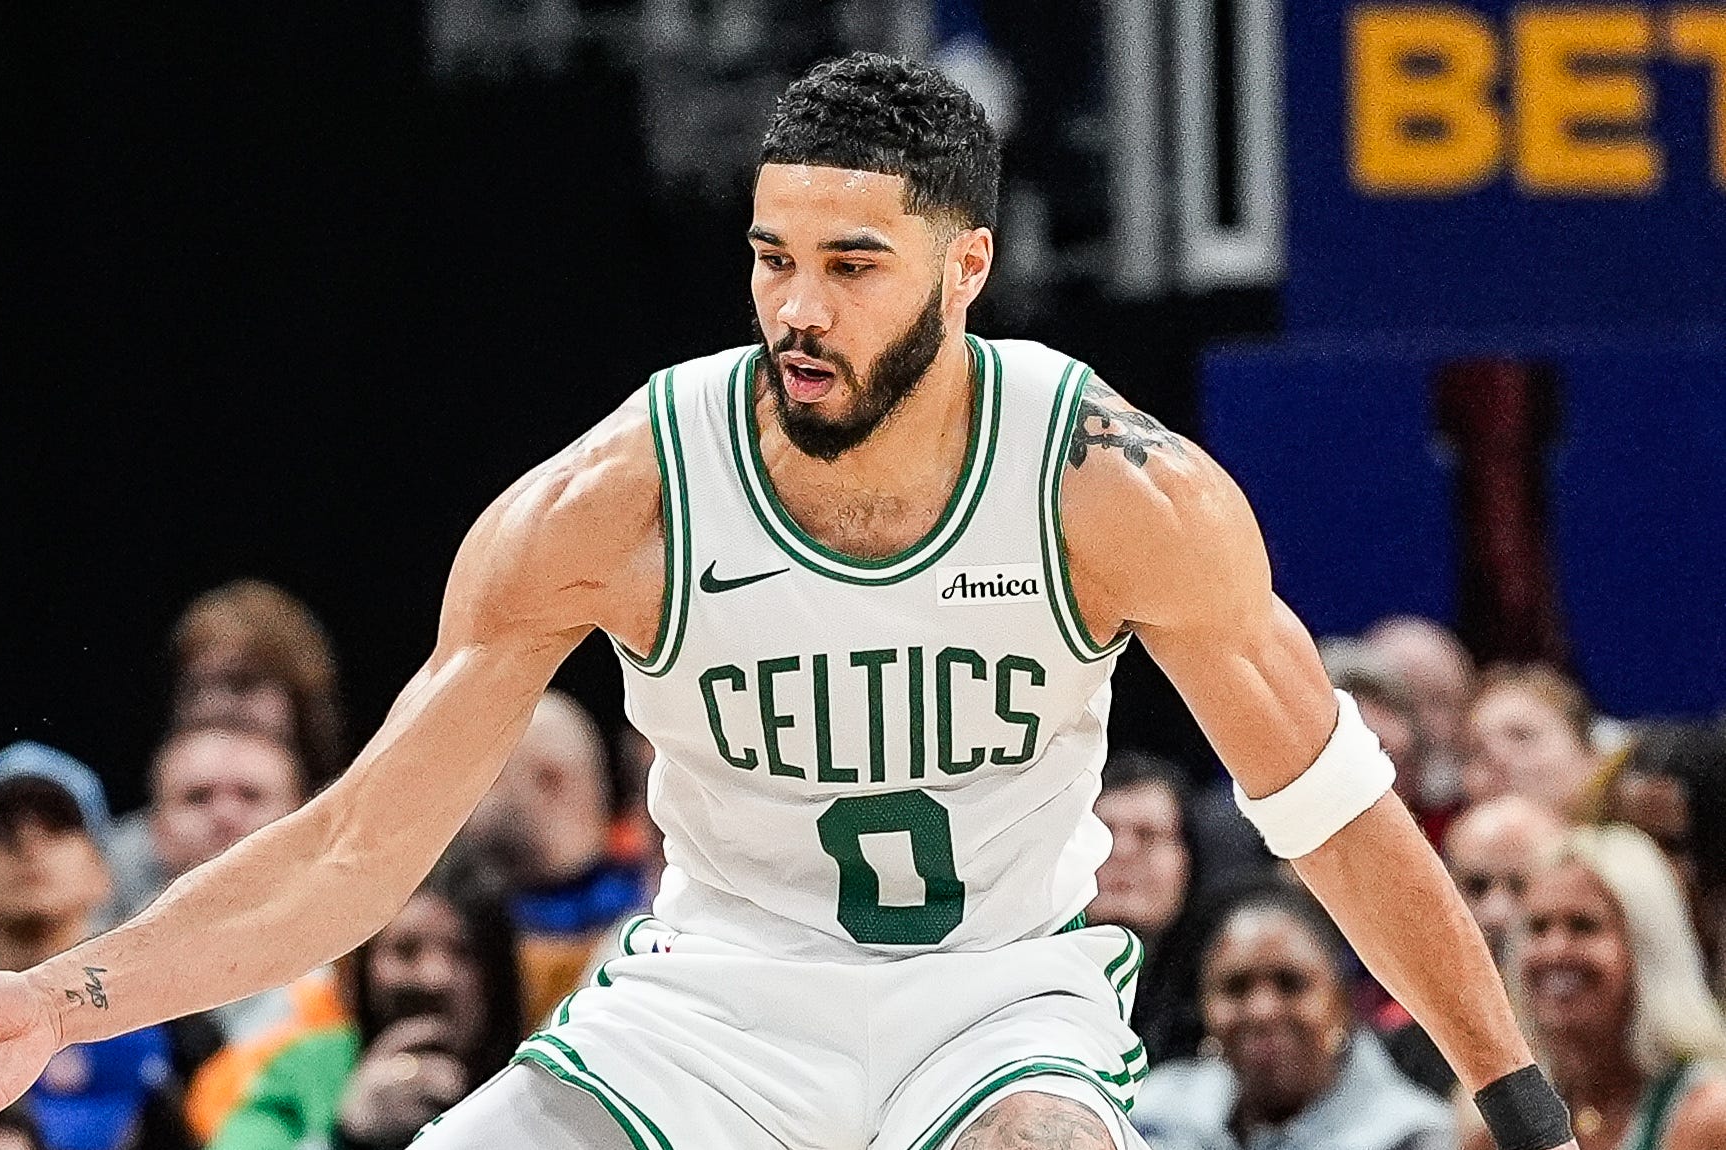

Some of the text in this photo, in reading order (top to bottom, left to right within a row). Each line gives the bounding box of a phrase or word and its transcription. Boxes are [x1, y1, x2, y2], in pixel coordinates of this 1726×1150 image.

[941, 572, 1039, 600] Amica
[699, 646, 1046, 783] CELTICS
[816, 788, 965, 945] 0
